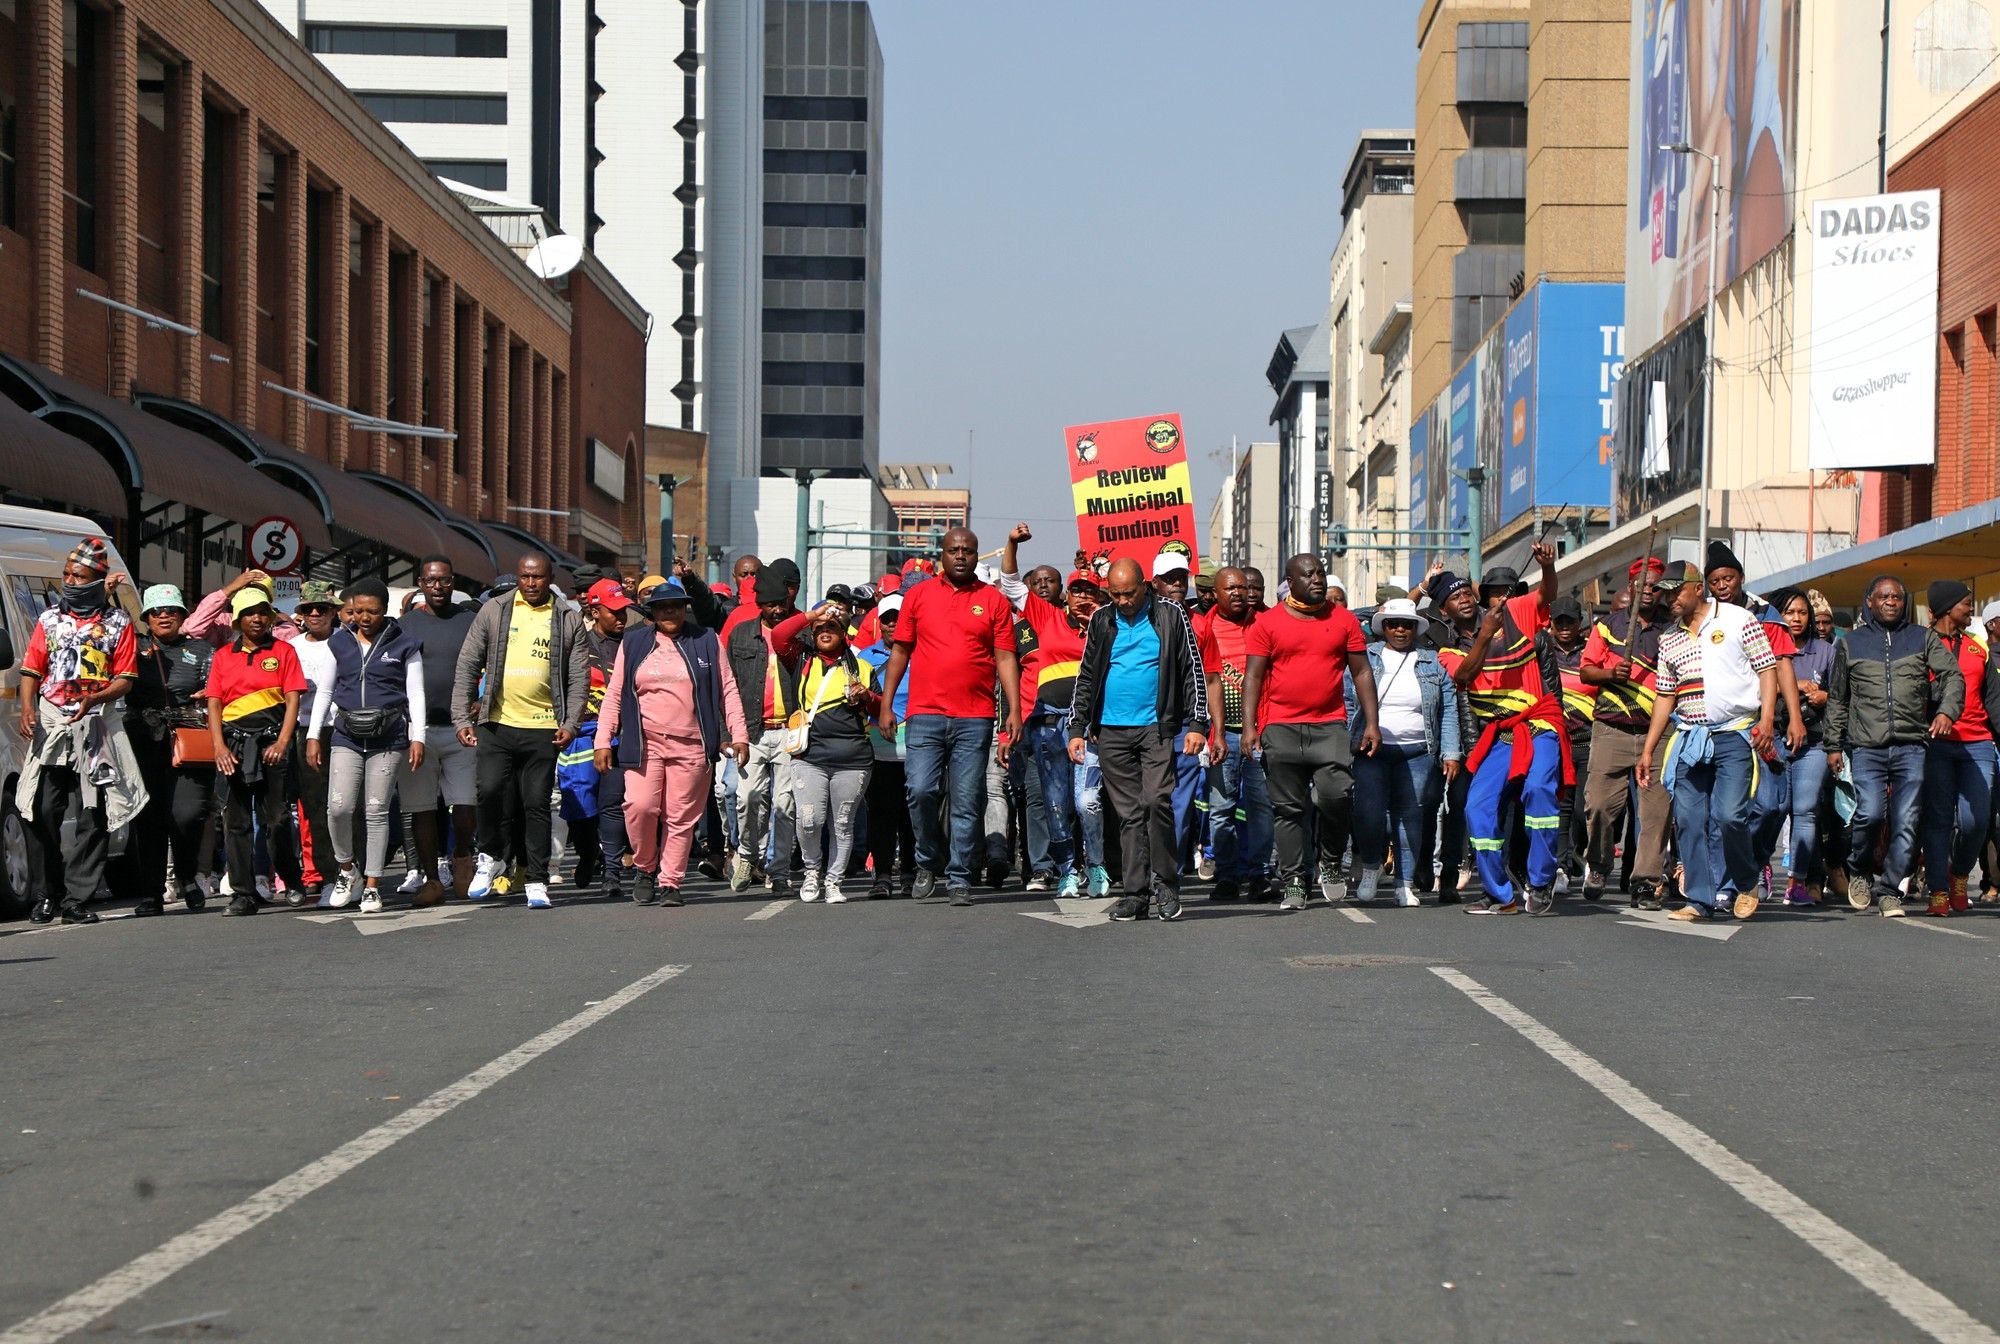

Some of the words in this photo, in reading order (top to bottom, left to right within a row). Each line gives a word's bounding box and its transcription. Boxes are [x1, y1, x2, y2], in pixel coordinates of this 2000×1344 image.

[1820, 200, 1931, 238] DADAS
[1832, 240, 1916, 266] Shoes
[1097, 465, 1167, 488] Review
[1086, 487, 1184, 517] Municipal
[1321, 474, 1329, 527] PREMIUM
[1097, 515, 1180, 543] funding!
[263, 530, 286, 561] S
[531, 649, 551, 660] 201
[532, 637, 550, 648] AN
